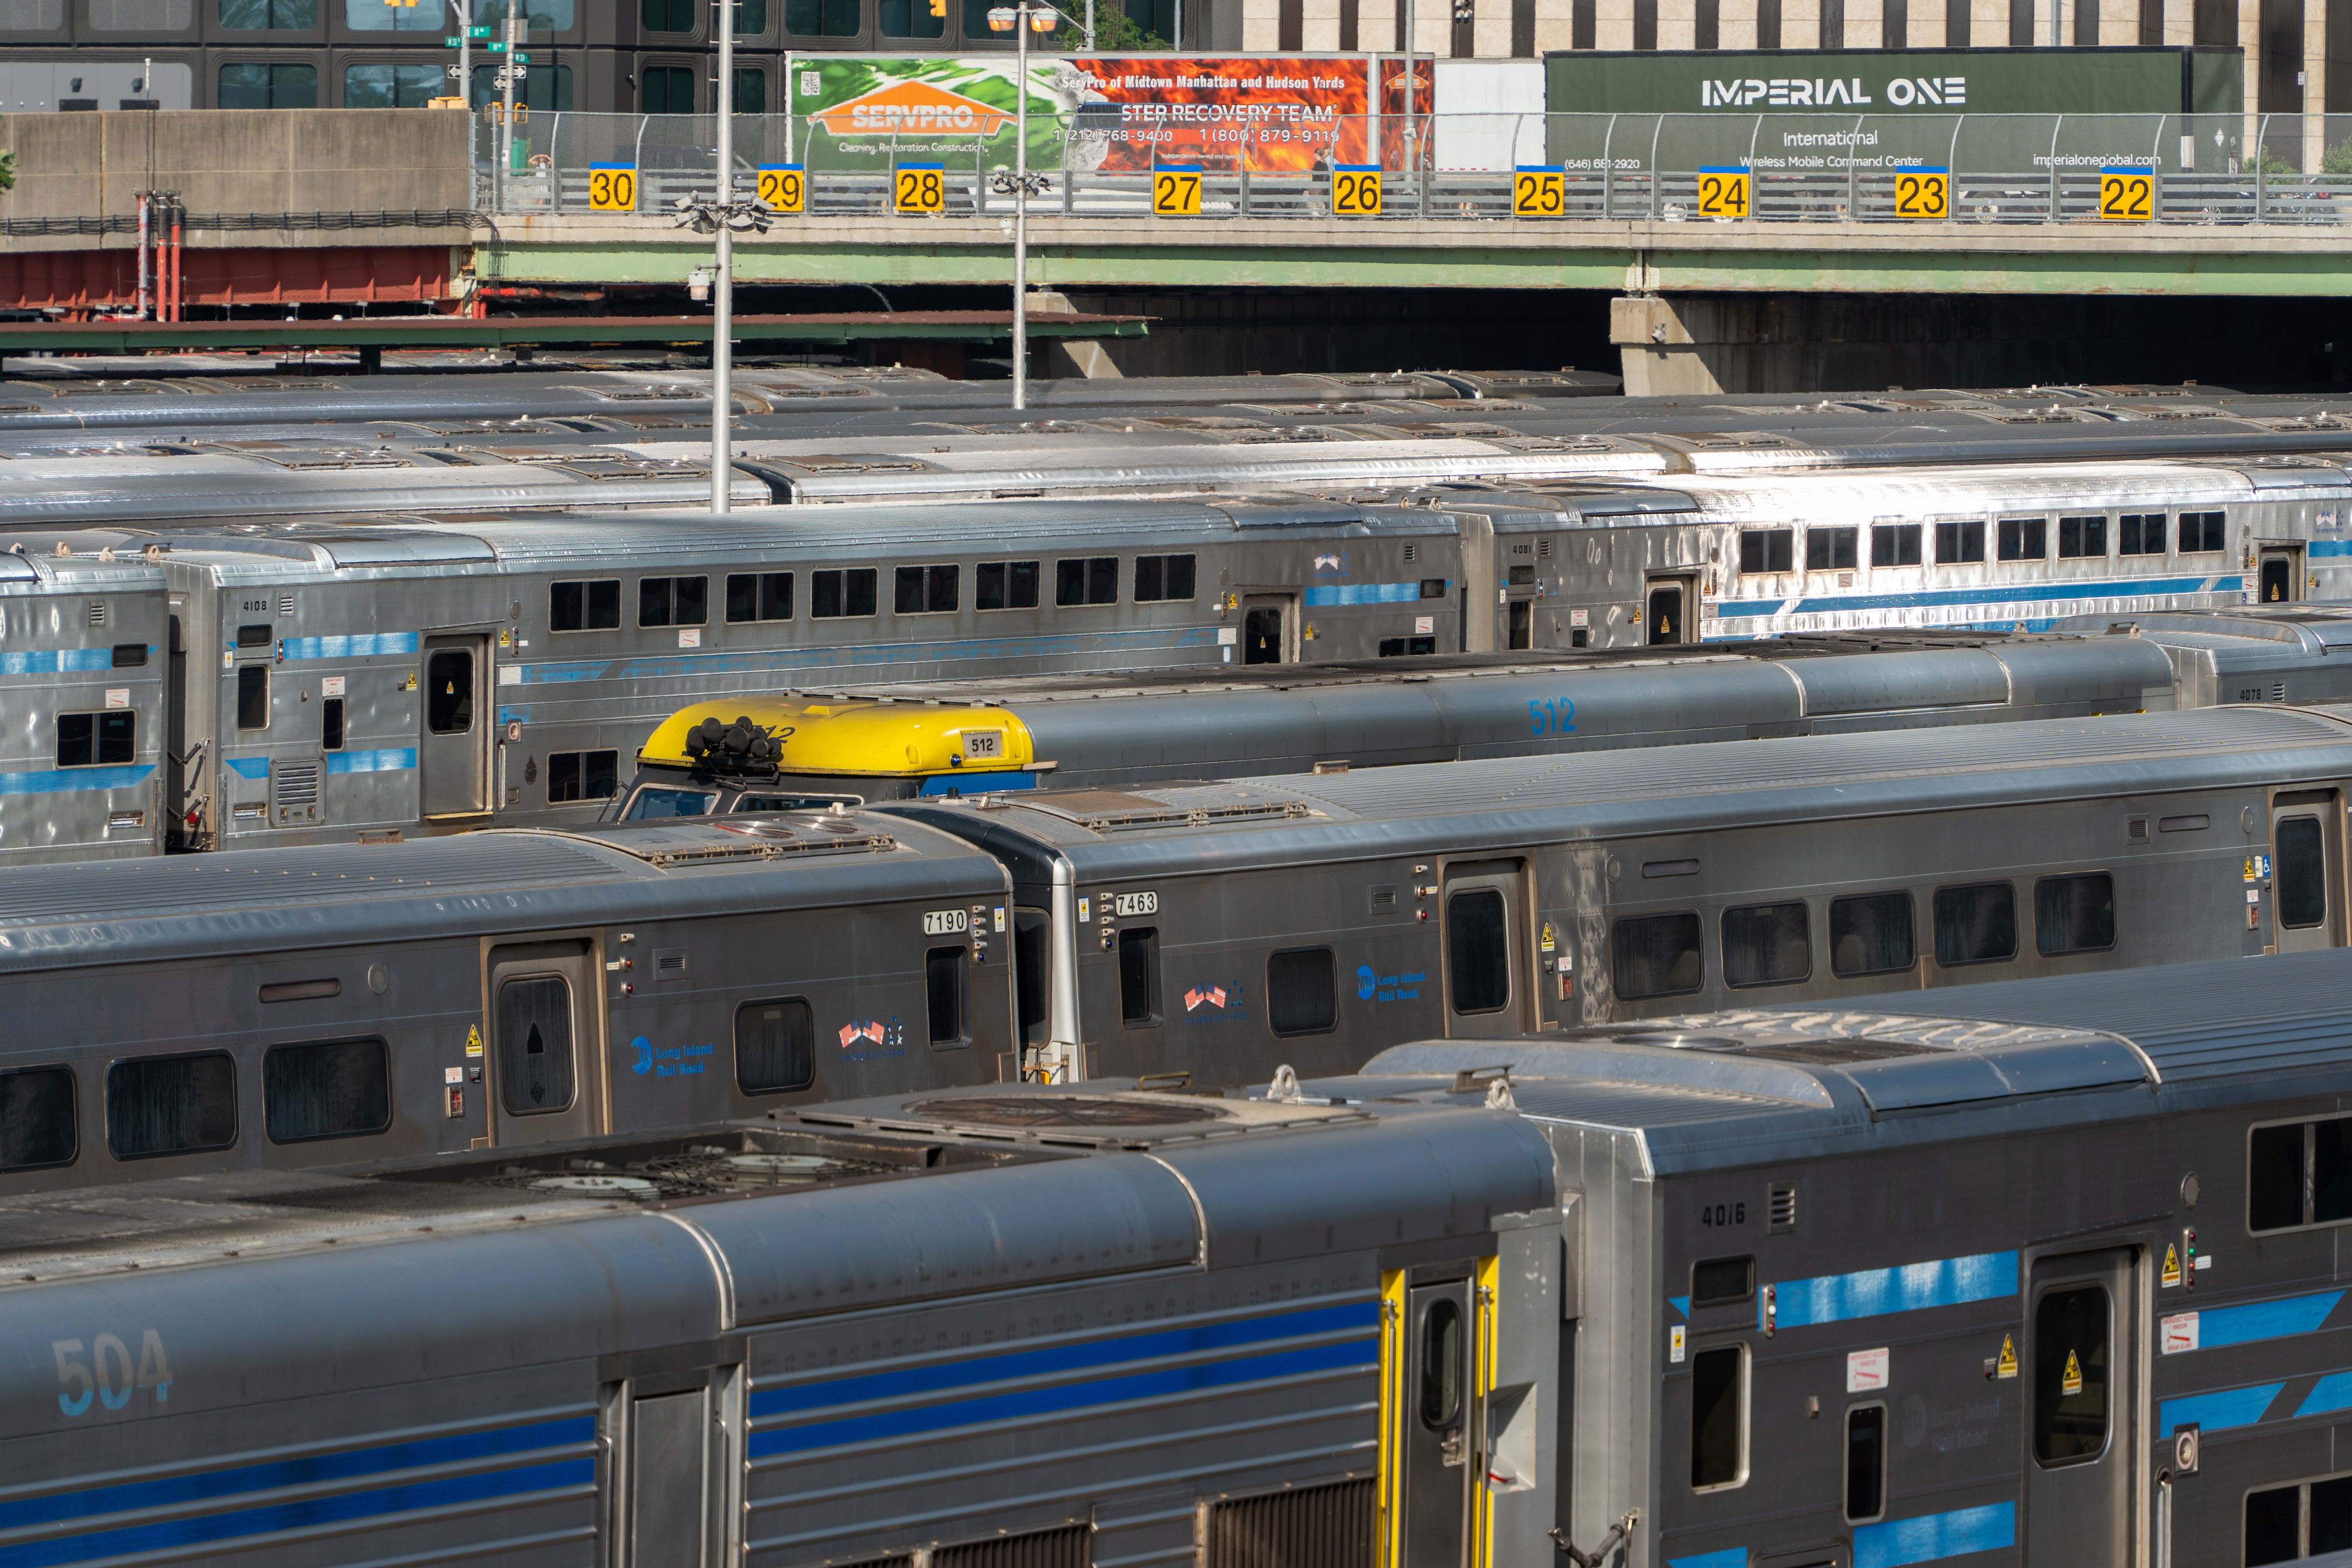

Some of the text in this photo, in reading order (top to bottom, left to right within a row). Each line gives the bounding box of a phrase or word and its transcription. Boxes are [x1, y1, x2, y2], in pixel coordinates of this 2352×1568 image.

[1062, 75, 1345, 89] ServPro of Midtown Manhattan and Hudson Yards
[1394, 78, 1420, 86] SERRO
[1701, 77, 1966, 106] IMPERIAL ONE
[1172, 104, 1273, 122] RECOVERY
[1277, 105, 1333, 122] TEAM
[1103, 129, 1173, 142] 768-9400
[1198, 128, 1206, 141] 1
[1260, 129, 1340, 143] 879-9119
[1783, 130, 1878, 147] International
[879, 142, 930, 153] Retoration.
[1565, 159, 1640, 171] (646) 681-2920
[1739, 155, 1924, 168] Wreless Mobile Command Center
[2033, 153, 2162, 168] imperialoneglobal.com
[593, 172, 632, 206] 30
[761, 173, 800, 207] 29
[900, 173, 940, 207] 28
[1158, 176, 1198, 210] 27
[1337, 175, 1378, 210] 26
[1518, 176, 1560, 211] 25
[1702, 177, 1746, 213] 24
[1900, 177, 1944, 214] 23
[2104, 178, 2149, 215] 22
[1513, 545, 1532, 555] 4081
[243, 600, 267, 611] 4108
[2240, 688, 2261, 701] 4078
[1528, 697, 1576, 736] 512
[972, 738, 993, 752] 512
[1117, 893, 1155, 914] 7463
[925, 911, 965, 932] 7190
[1377, 971, 1425, 986] Long Island
[1378, 988, 1418, 1002] Rail Road
[1186, 1017, 1195, 1025] WE
[1230, 1011, 1246, 1021] PRIDE
[656, 1042, 713, 1060] Long Island
[657, 1061, 704, 1077] Rail Road
[1702, 1202, 1745, 1227] 4016
[51, 1329, 173, 1416] 504
[1965, 1399, 2000, 1421] Island
